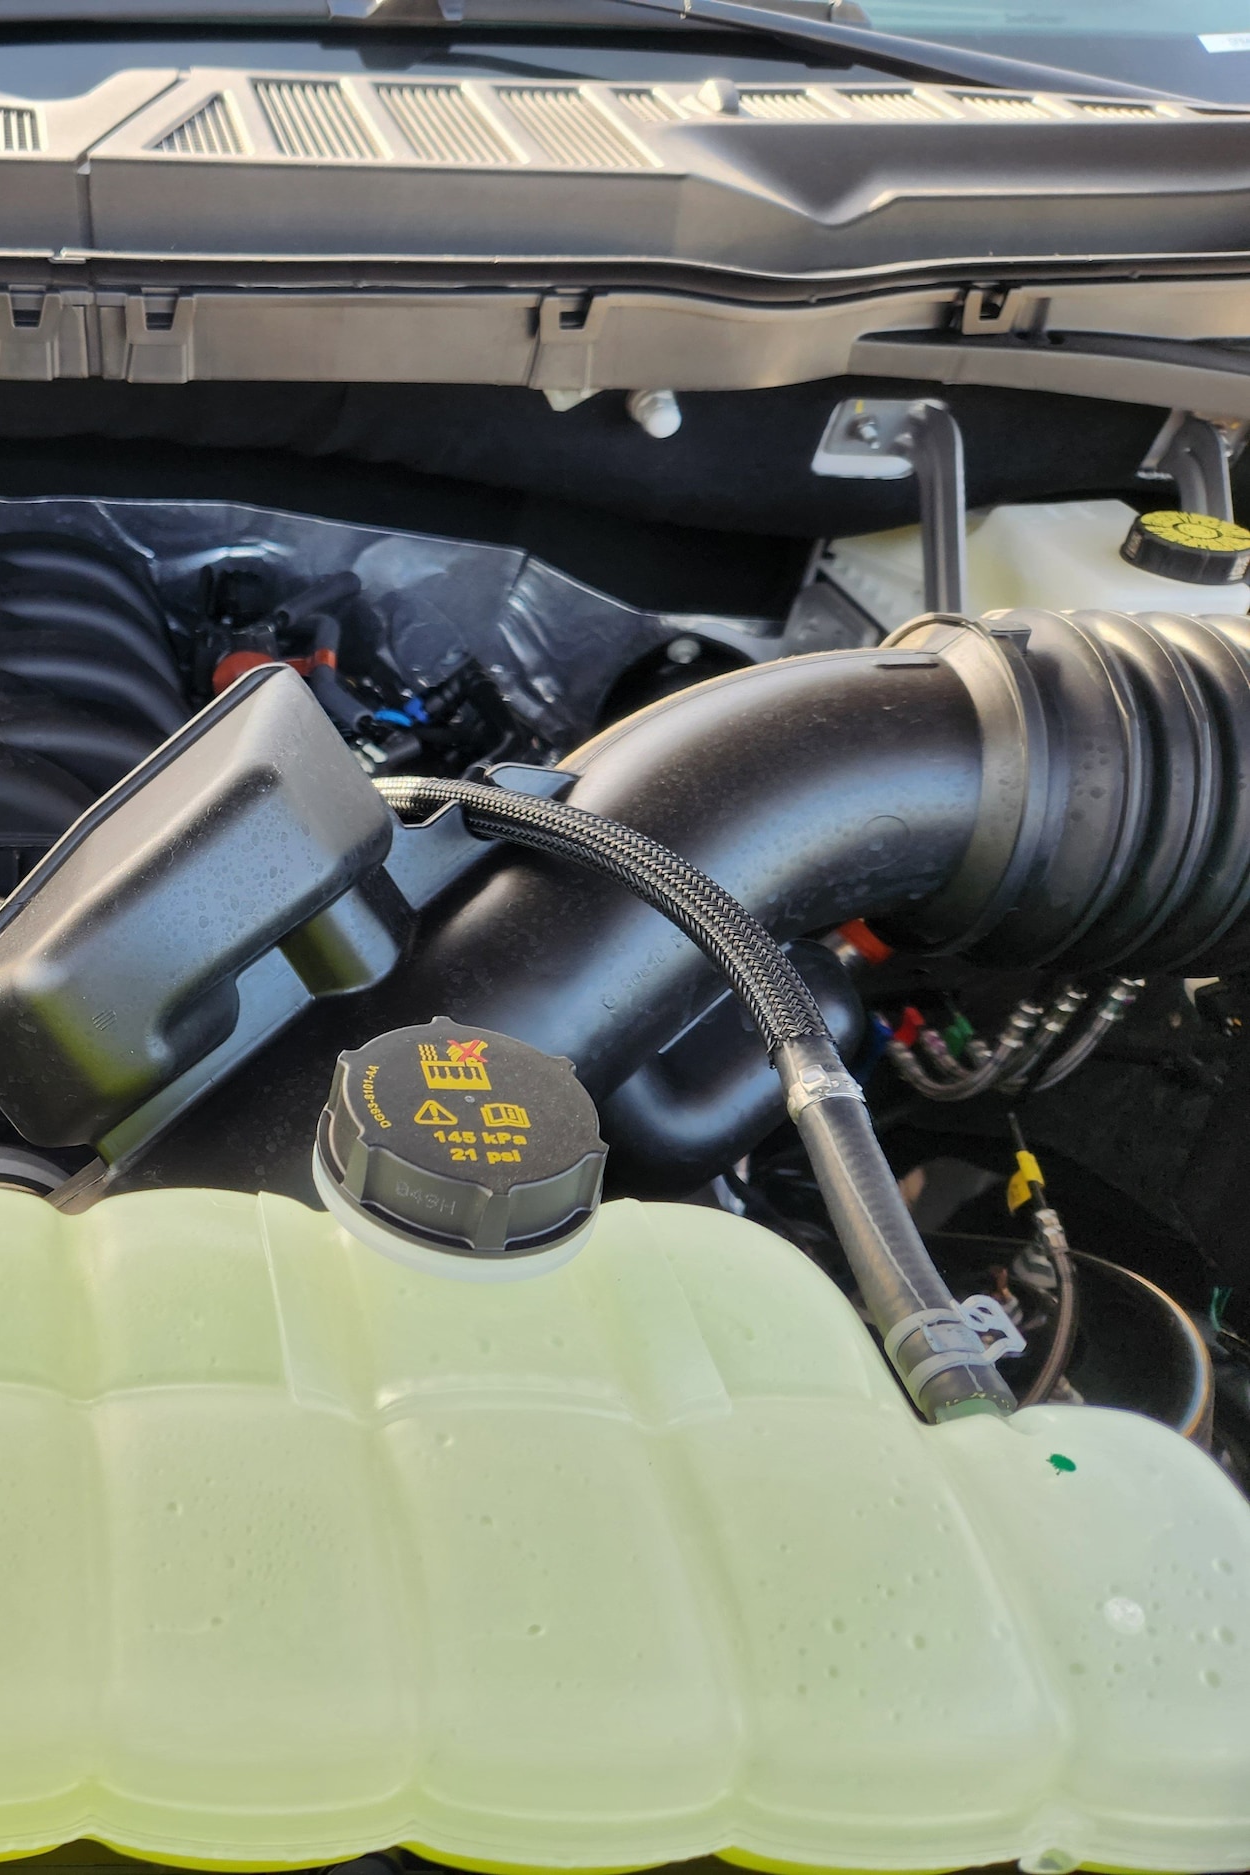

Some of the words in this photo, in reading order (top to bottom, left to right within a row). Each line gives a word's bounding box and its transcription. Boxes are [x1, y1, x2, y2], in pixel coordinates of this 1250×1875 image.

[362, 1064, 391, 1129] DG93-8101-AA
[433, 1130, 477, 1145] 145
[481, 1132, 527, 1146] kPa
[449, 1147, 478, 1162] 21
[485, 1149, 522, 1165] psi
